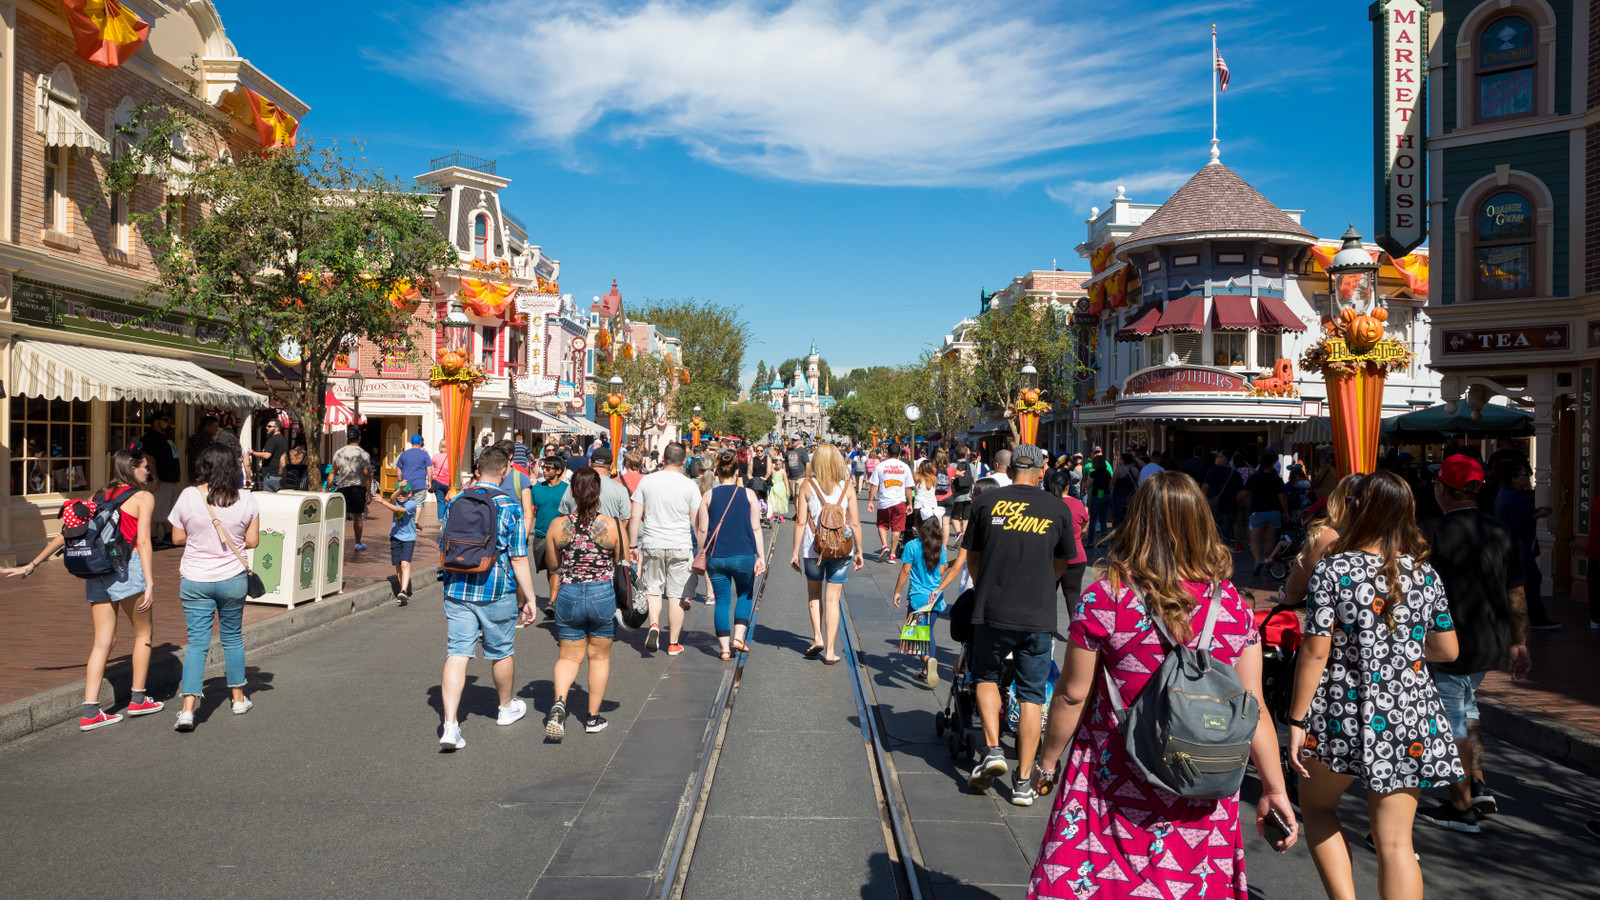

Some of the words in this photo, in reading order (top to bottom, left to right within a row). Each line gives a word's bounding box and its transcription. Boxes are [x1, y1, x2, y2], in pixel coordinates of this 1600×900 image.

[1394, 9, 1416, 122] MARKET
[1395, 134, 1415, 229] HOUSE
[22, 291, 44, 300] GIFTS
[14, 301, 51, 313] JEWELRY
[1478, 332, 1531, 348] TEA
[1131, 370, 1163, 391] DISNEY
[1164, 368, 1234, 390] CLOTHIERS
[1580, 391, 1591, 512] STARBUCKS
[991, 500, 1030, 516] RISE
[1003, 514, 1053, 535] SHINE
